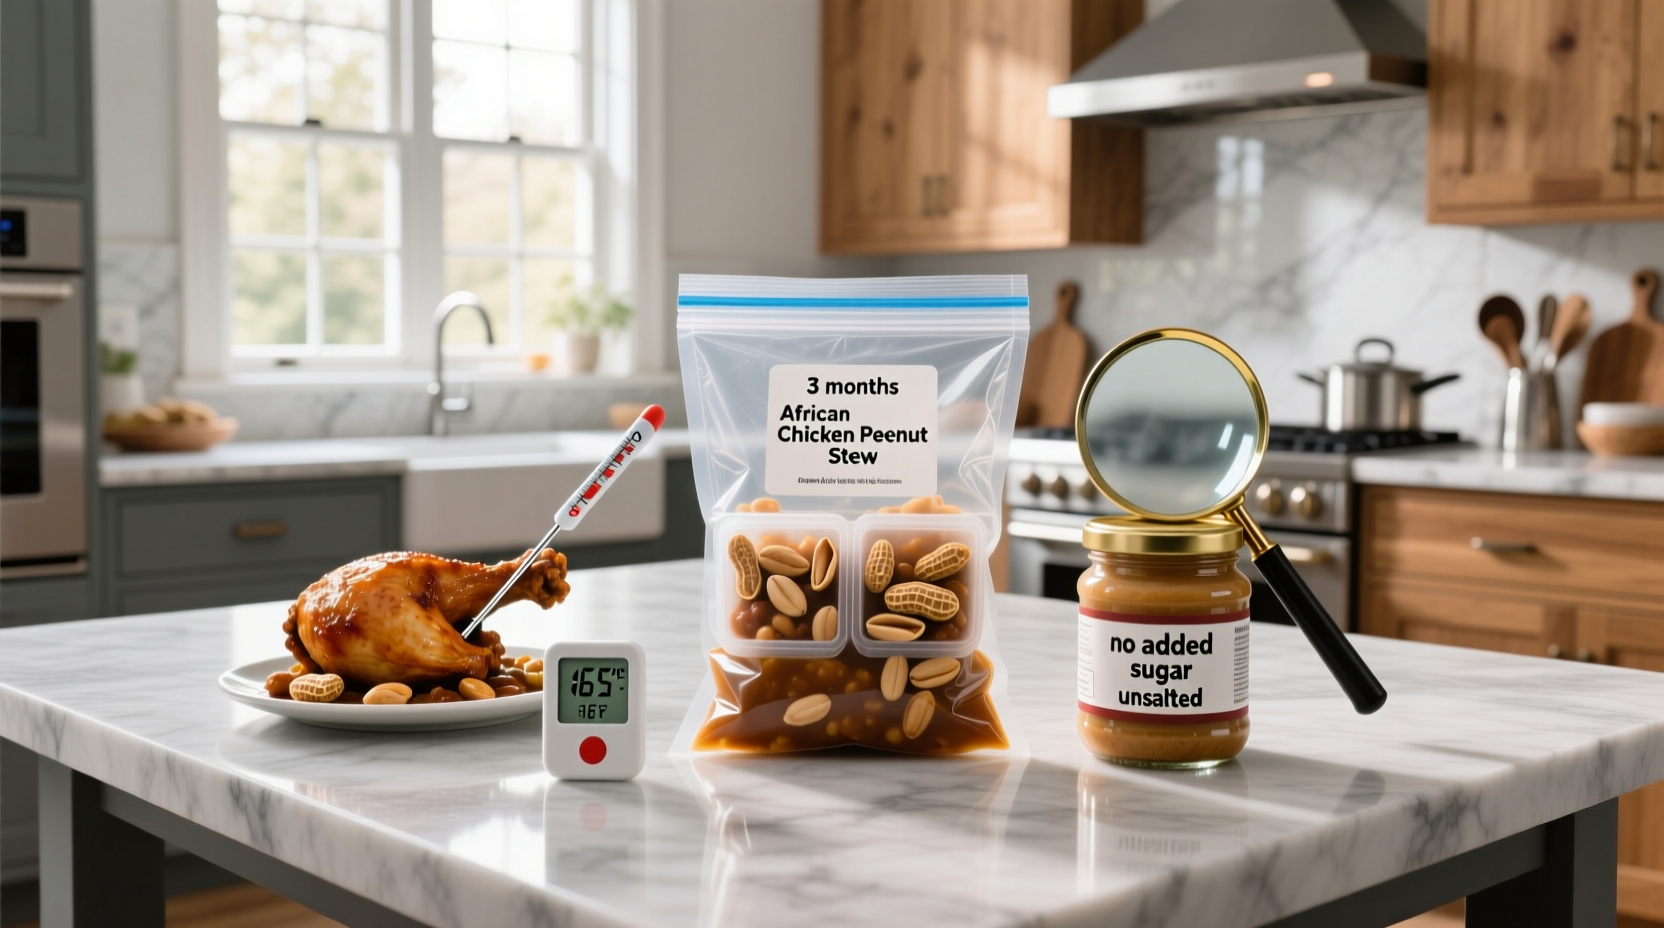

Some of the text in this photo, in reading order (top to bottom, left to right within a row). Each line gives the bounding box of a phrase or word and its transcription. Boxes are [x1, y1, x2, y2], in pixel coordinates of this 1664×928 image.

[806, 377, 899, 395] 3 months
[779, 404, 850, 422] African
[777, 425, 928, 443] Chicken Peenut
[828, 447, 878, 465] Stew
[1110, 636, 1136, 654] no
[1141, 632, 1213, 656] added
[1130, 662, 1193, 685] sugar
[1118, 687, 1203, 708] unsalted
